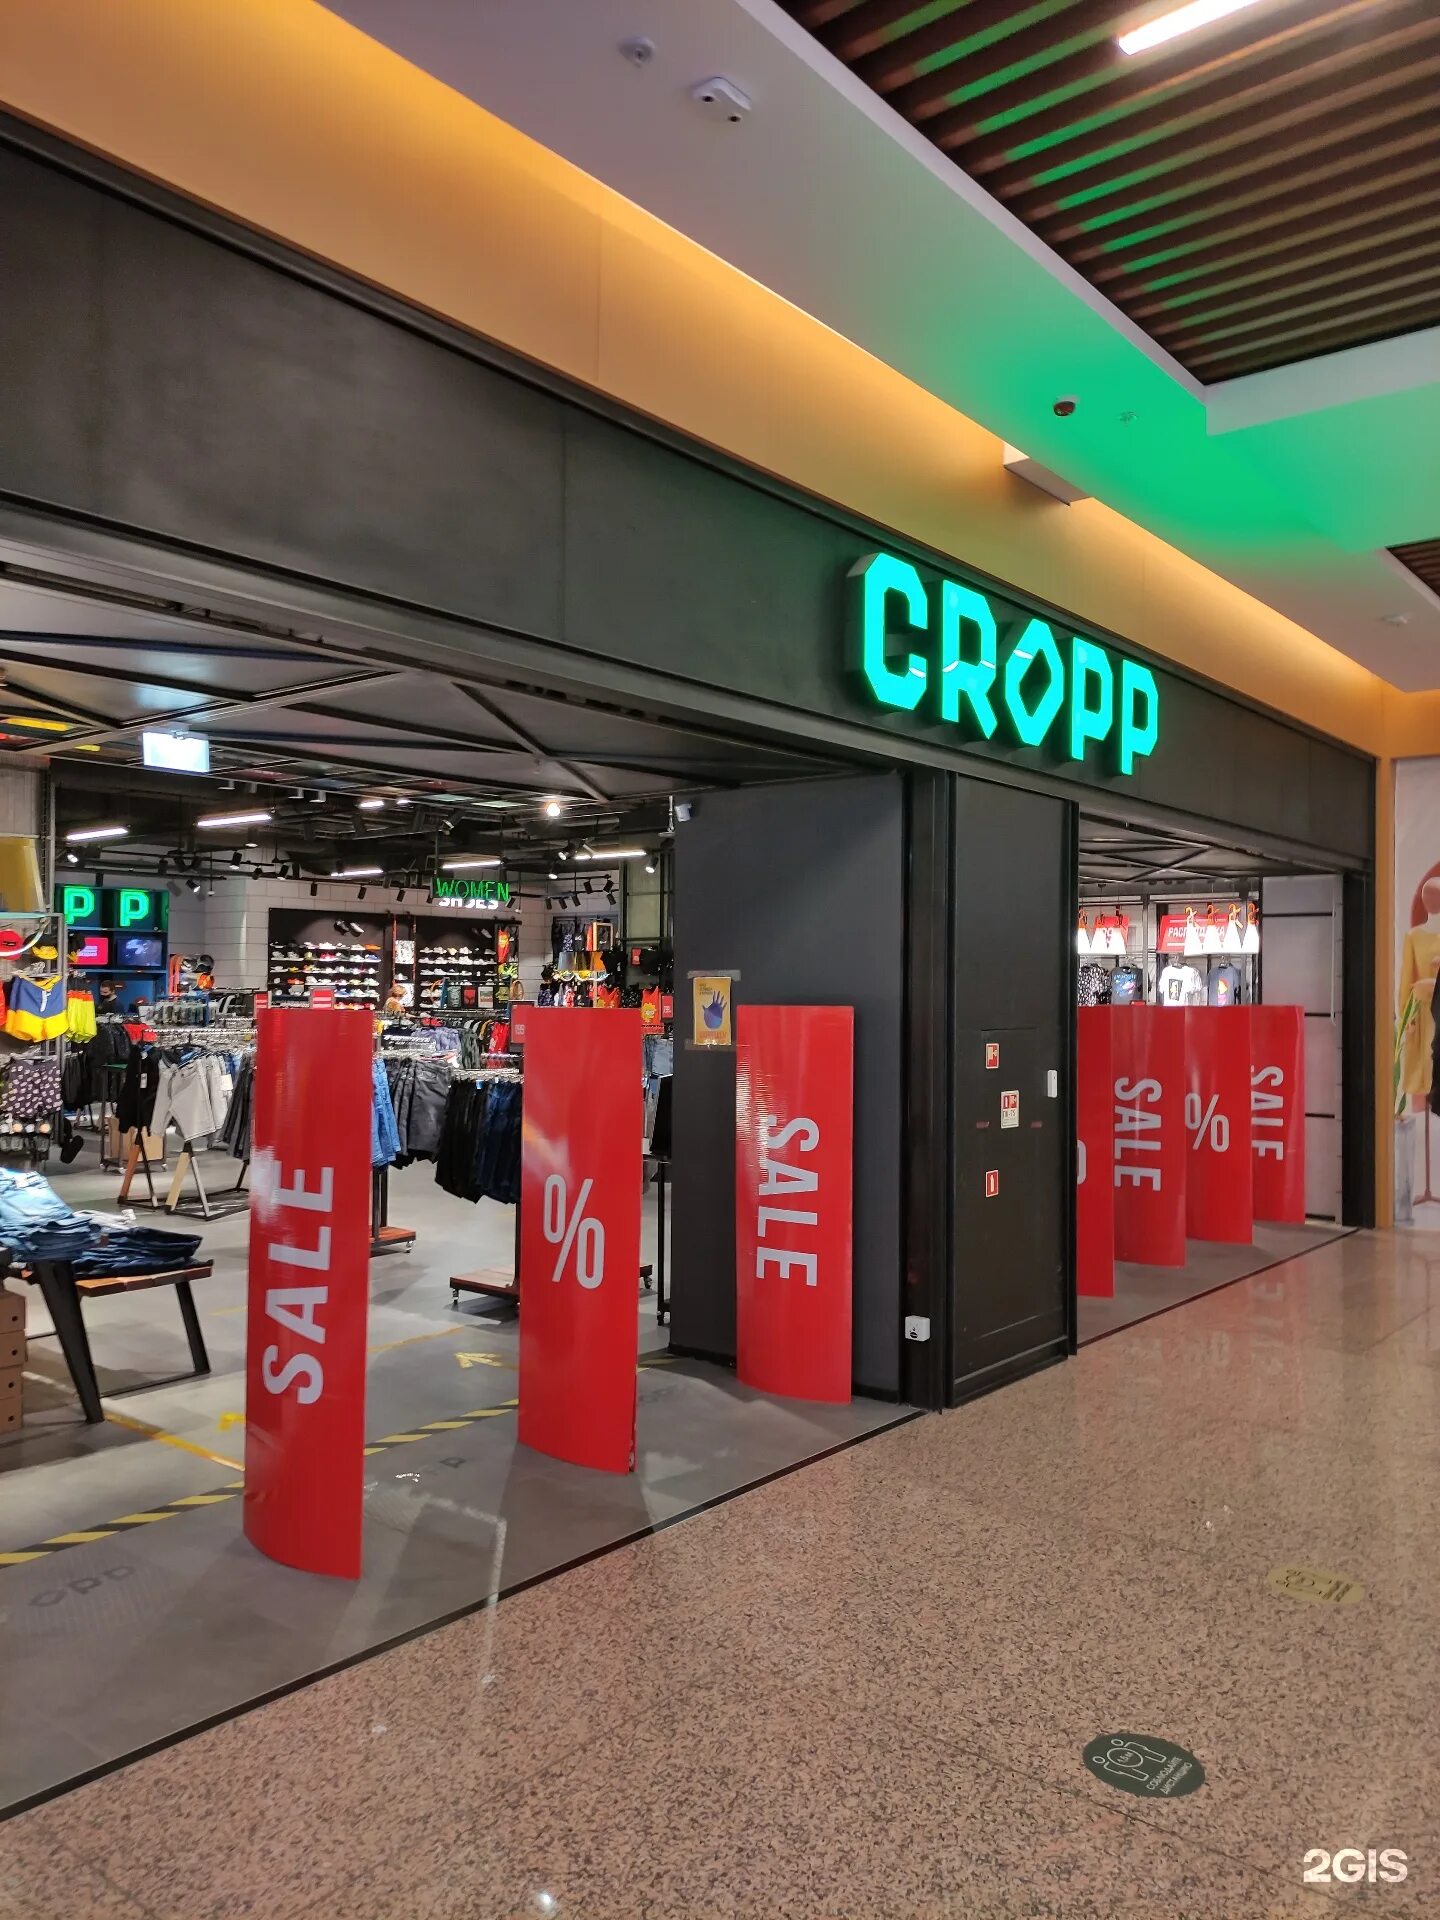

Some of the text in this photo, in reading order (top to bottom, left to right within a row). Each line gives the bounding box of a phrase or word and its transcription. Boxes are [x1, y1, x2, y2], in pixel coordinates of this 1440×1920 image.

[860, 552, 1159, 776] CROPP
[437, 877, 511, 903] WOMEN
[756, 1114, 820, 1287] SALE
[1114, 1077, 1163, 1191] SALE
[261, 1160, 335, 1406] SALE
